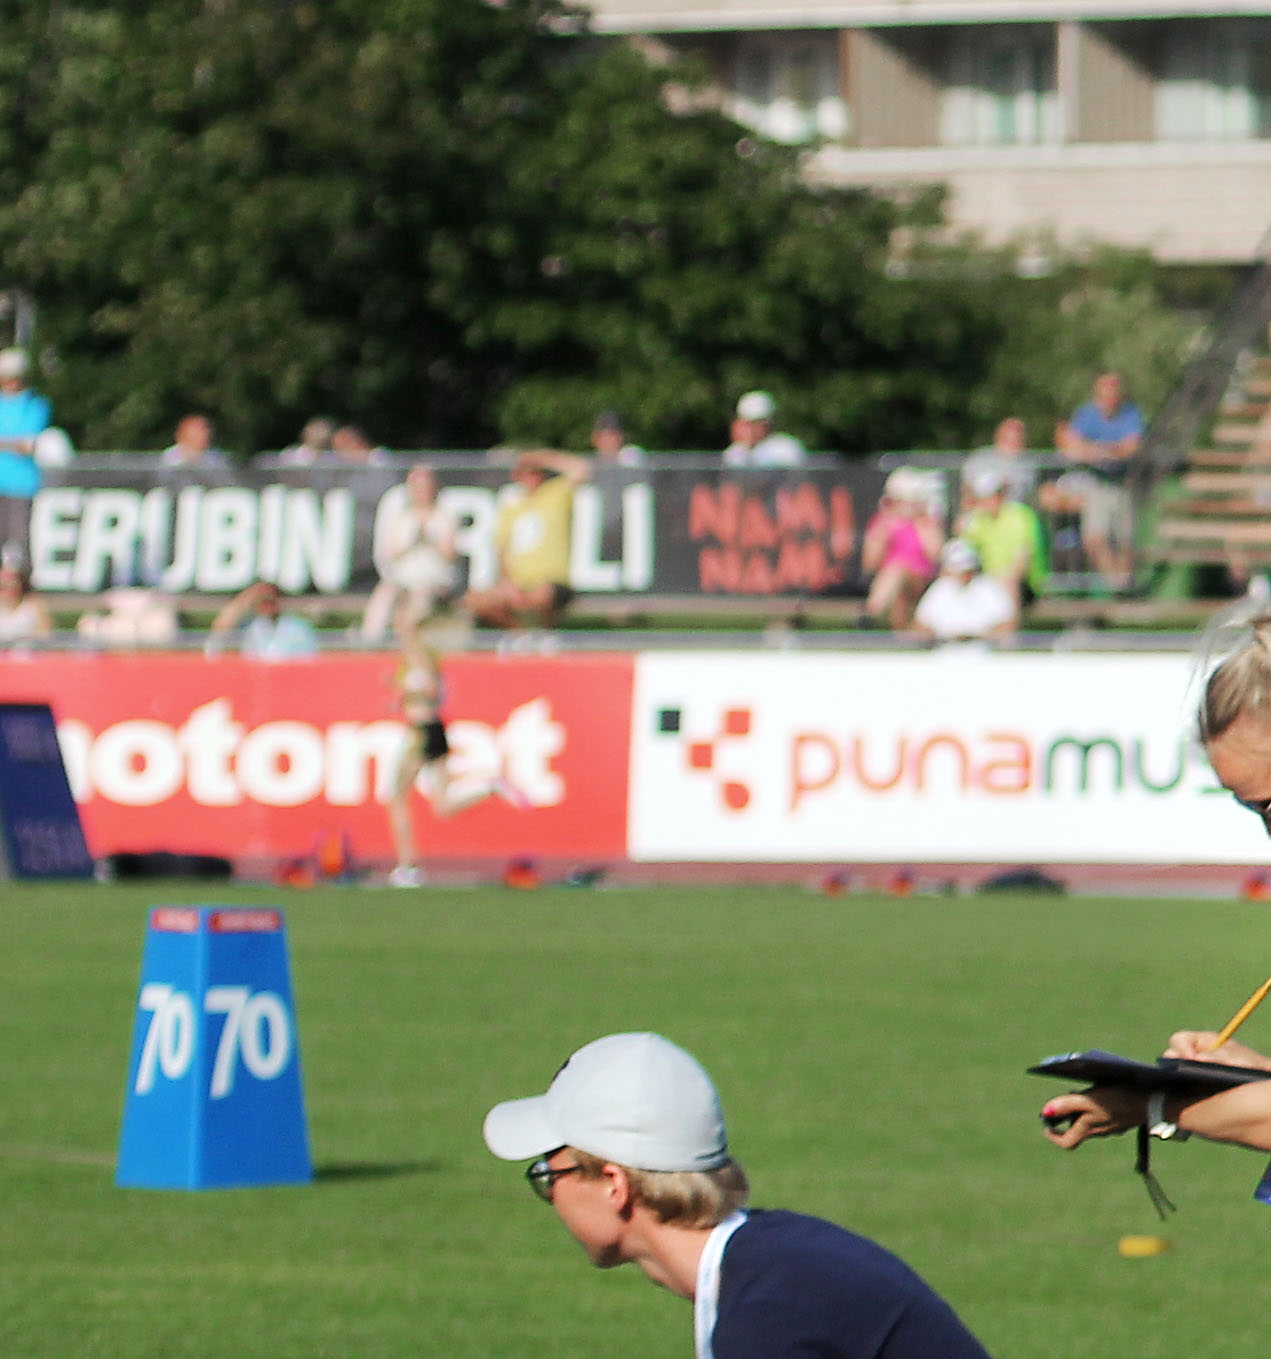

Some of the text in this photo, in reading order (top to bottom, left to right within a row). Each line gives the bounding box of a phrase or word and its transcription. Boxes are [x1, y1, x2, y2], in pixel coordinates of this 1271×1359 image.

[790, 733, 1234, 814] punamu
[135, 981, 291, 1100] 70 70
